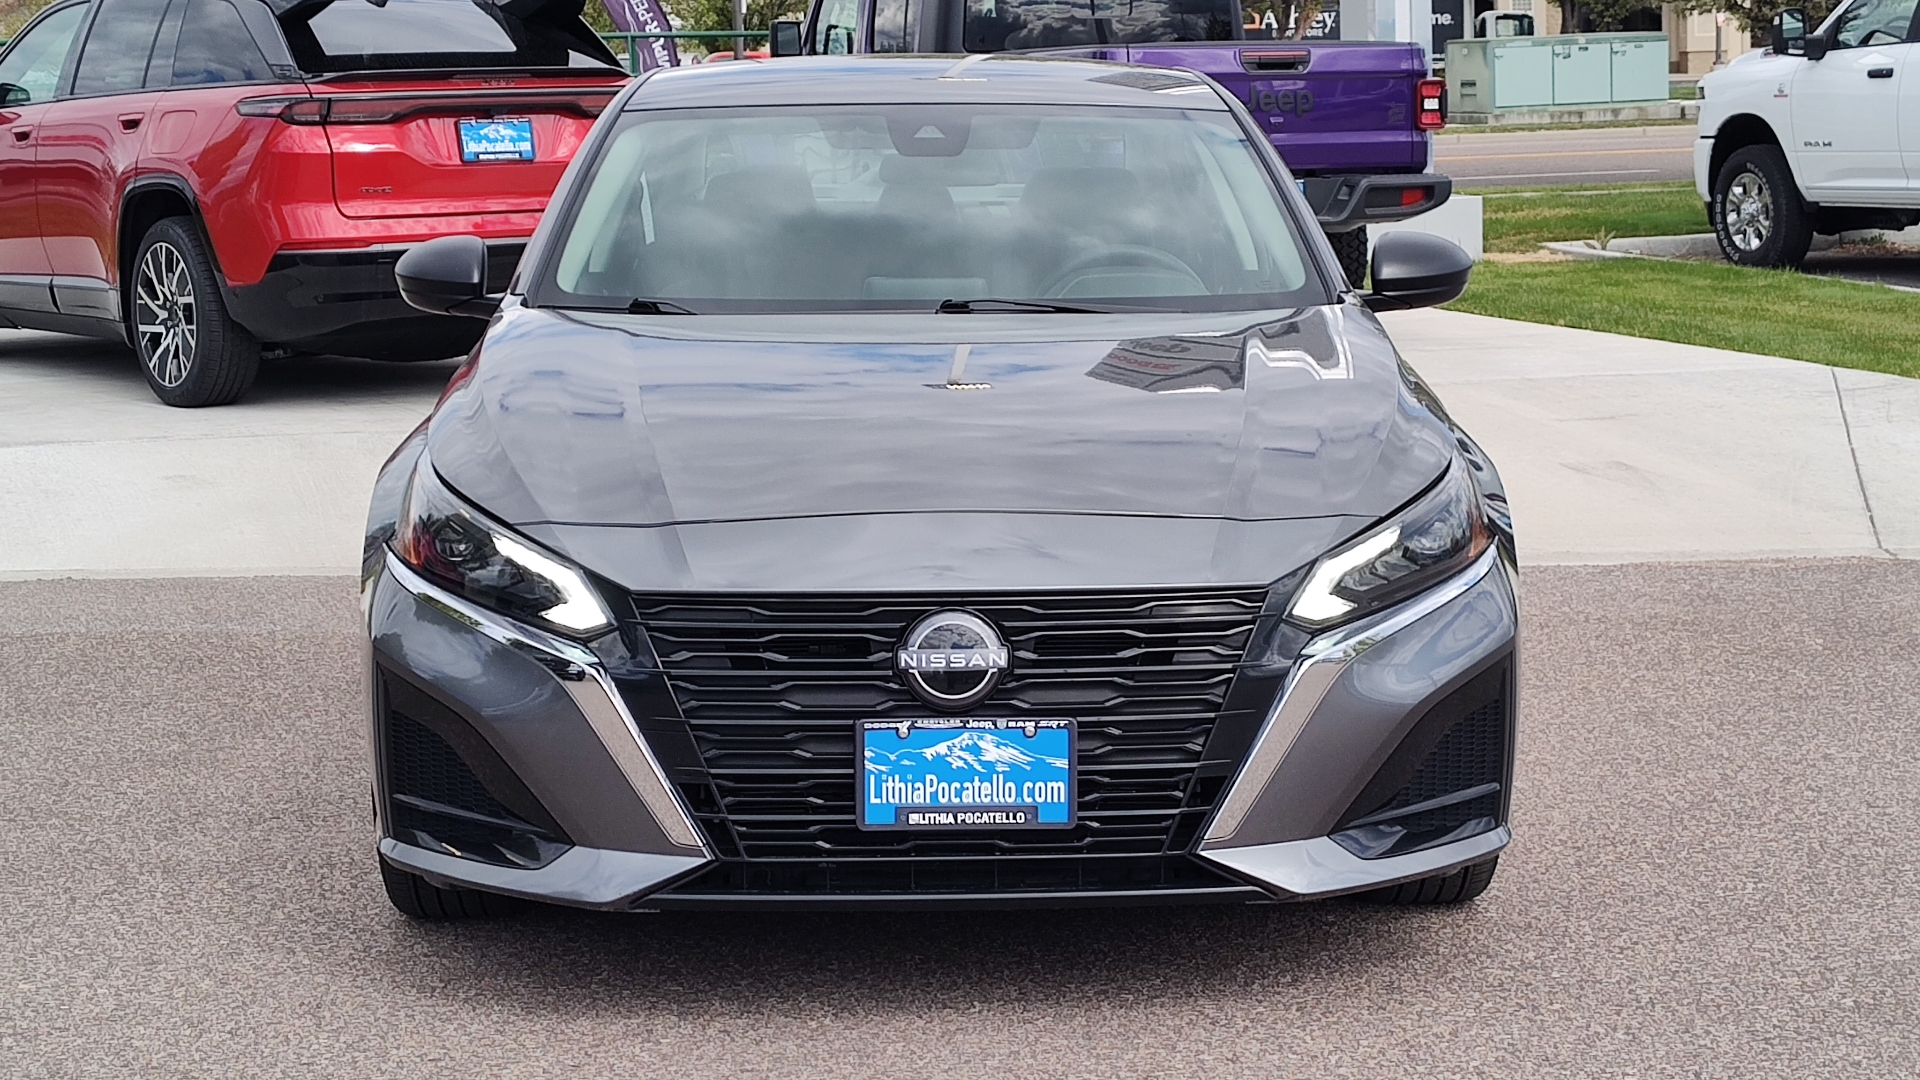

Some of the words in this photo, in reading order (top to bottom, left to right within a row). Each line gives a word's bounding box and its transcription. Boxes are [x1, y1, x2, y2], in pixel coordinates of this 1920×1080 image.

[1248, 84, 1314, 117] Jeep
[900, 652, 1006, 668] NISSAN
[965, 718, 993, 730] Jeep
[869, 773, 1065, 804] LithiaPocatello.com
[919, 812, 955, 825] LITHIA
[957, 812, 1026, 824] POCATELLO
